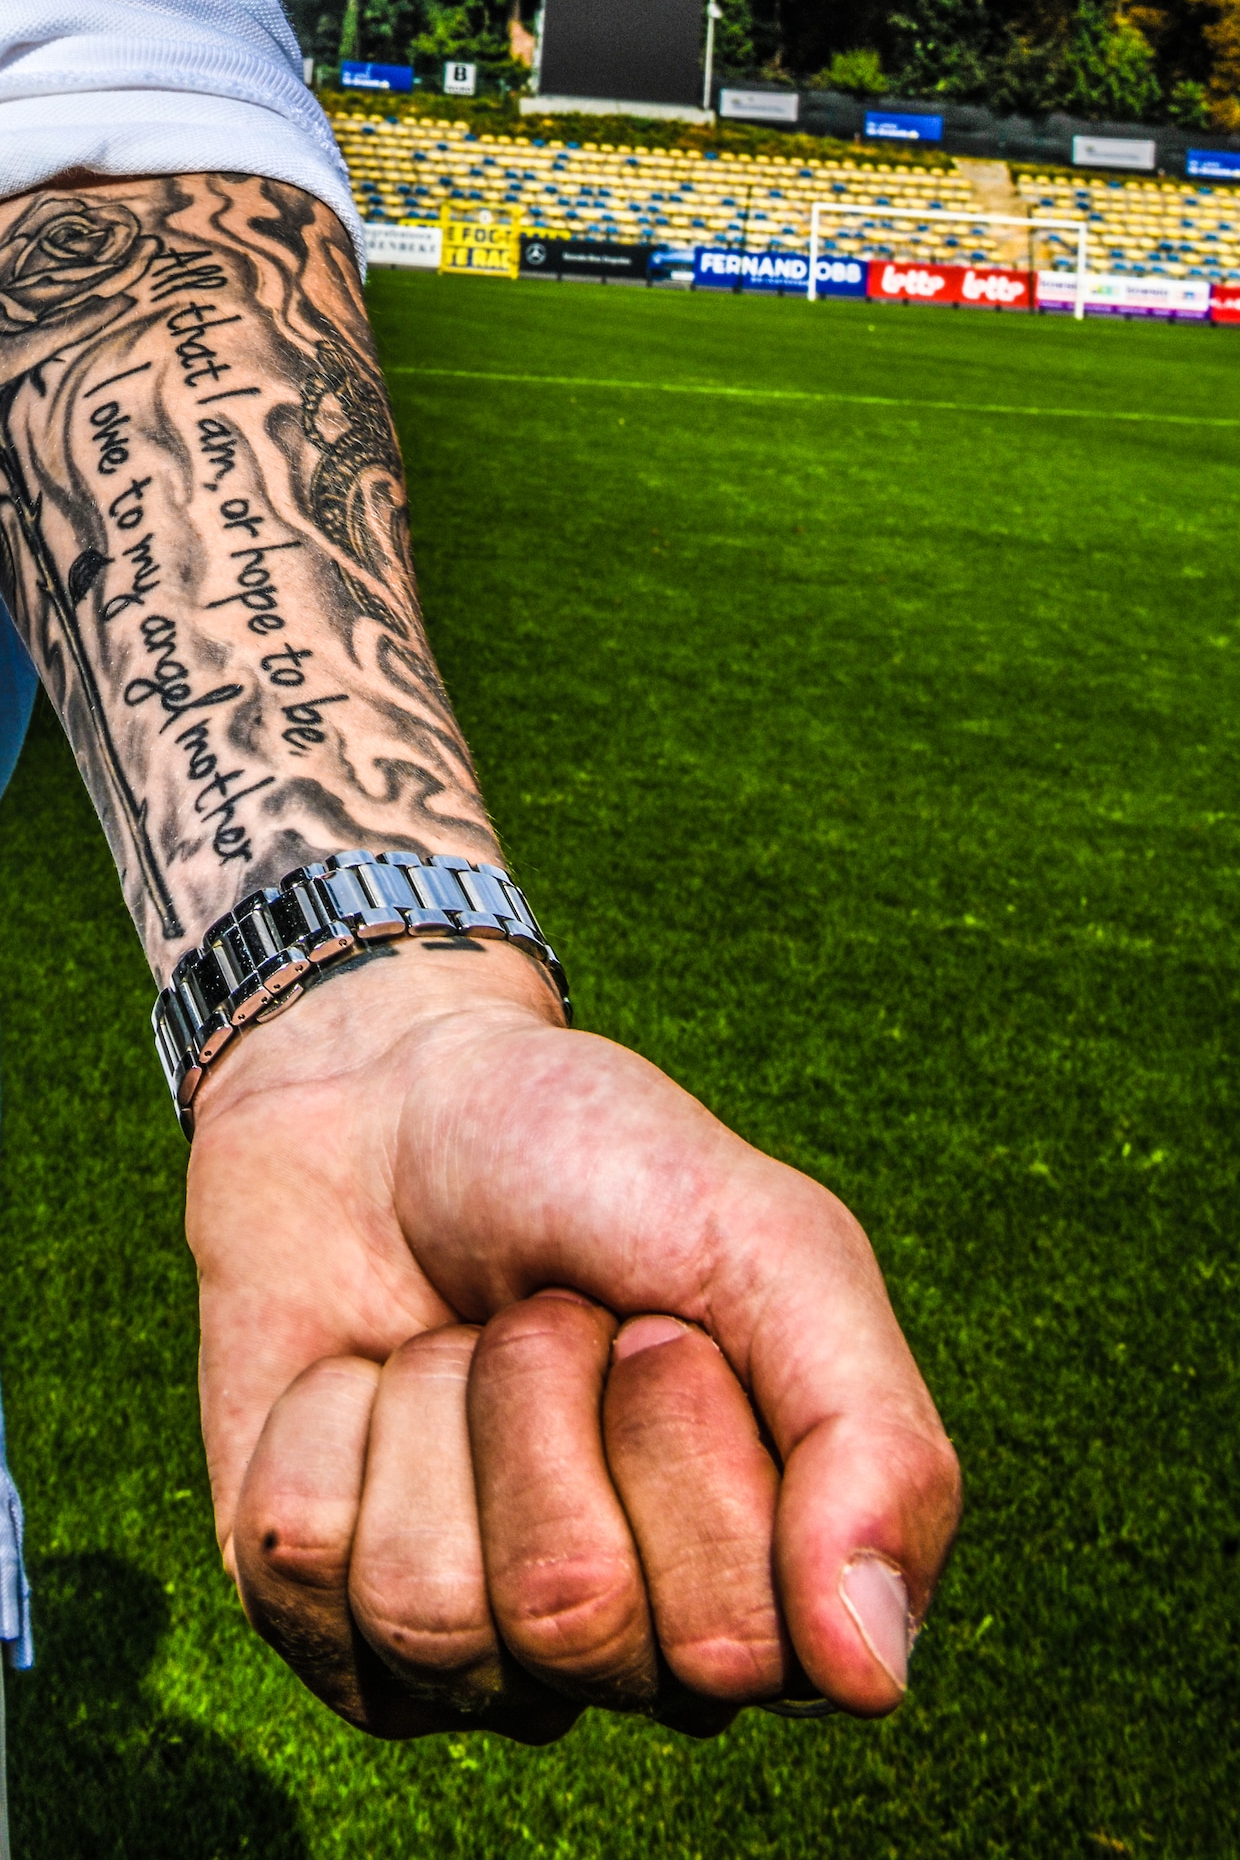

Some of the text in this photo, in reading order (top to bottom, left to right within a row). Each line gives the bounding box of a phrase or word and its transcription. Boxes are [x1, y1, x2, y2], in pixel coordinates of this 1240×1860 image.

[151, 248, 228, 302] All
[700, 252, 808, 280] FERNAND
[167, 301, 242, 387] that
[89, 400, 131, 475] owe
[198, 418, 237, 492] am,
[109, 476, 152, 530] to
[220, 498, 264, 538] or
[102, 533, 161, 621] my
[205, 541, 302, 636] hope
[124, 614, 245, 734] angel
[260, 643, 313, 687] to
[174, 718, 277, 867] mother
